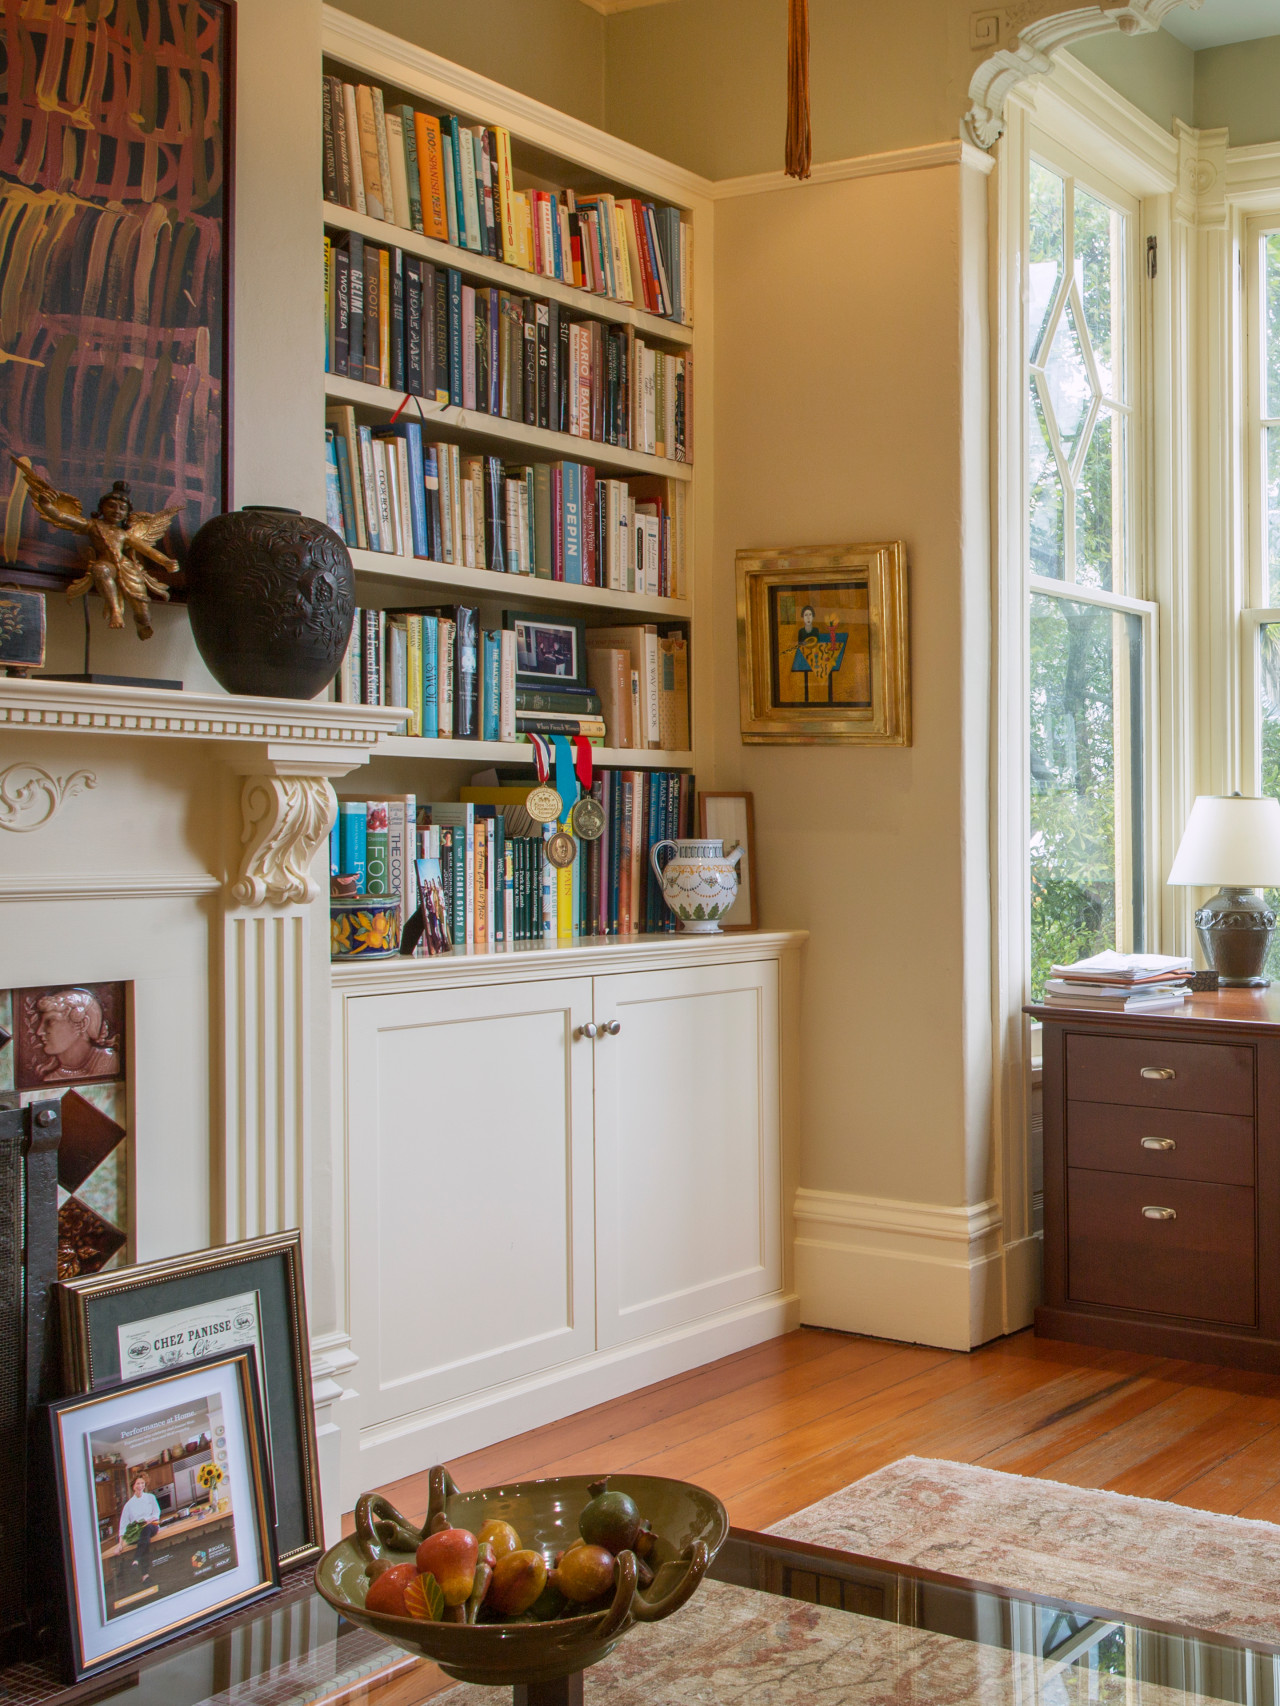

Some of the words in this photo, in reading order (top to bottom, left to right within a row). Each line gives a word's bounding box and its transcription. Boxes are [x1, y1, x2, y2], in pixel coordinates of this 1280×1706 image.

[338, 129, 349, 162] Spanish
[406, 116, 417, 162] TAPAS
[429, 154, 440, 195] SPANISH
[493, 183, 502, 223] PINTXOS
[351, 270, 362, 313] GJELINA
[369, 276, 378, 318] ROOTS
[410, 288, 419, 329] HOME
[437, 284, 446, 369] HUCKLEBERRY
[560, 322, 569, 343] stir
[410, 331, 420, 371] MADE
[527, 344, 535, 382] SPQR
[539, 344, 547, 366] A16
[581, 331, 589, 376] MARIO
[580, 388, 590, 437] BATALI
[379, 470, 387, 496] COOK
[381, 498, 389, 523] BOOK
[587, 501, 595, 529] Jacques
[567, 503, 577, 556] PEPIN
[367, 620, 379, 637] The
[447, 623, 455, 640] When
[367, 640, 379, 671] French
[425, 662, 437, 707] SAVOIE
[651, 688, 656, 699] TO
[565, 723, 579, 731] Women
[391, 833, 401, 856] THE
[477, 851, 485, 870] From
[391, 859, 401, 895] COOK
[477, 871, 485, 892] Tapas
[456, 901, 464, 926] GYPSY
[154, 1333, 184, 1351] CHEZ
[188, 1320, 232, 1342] PANISSE
[121, 1421, 165, 1438] Performance
[174, 1411, 196, 1421] Home.
